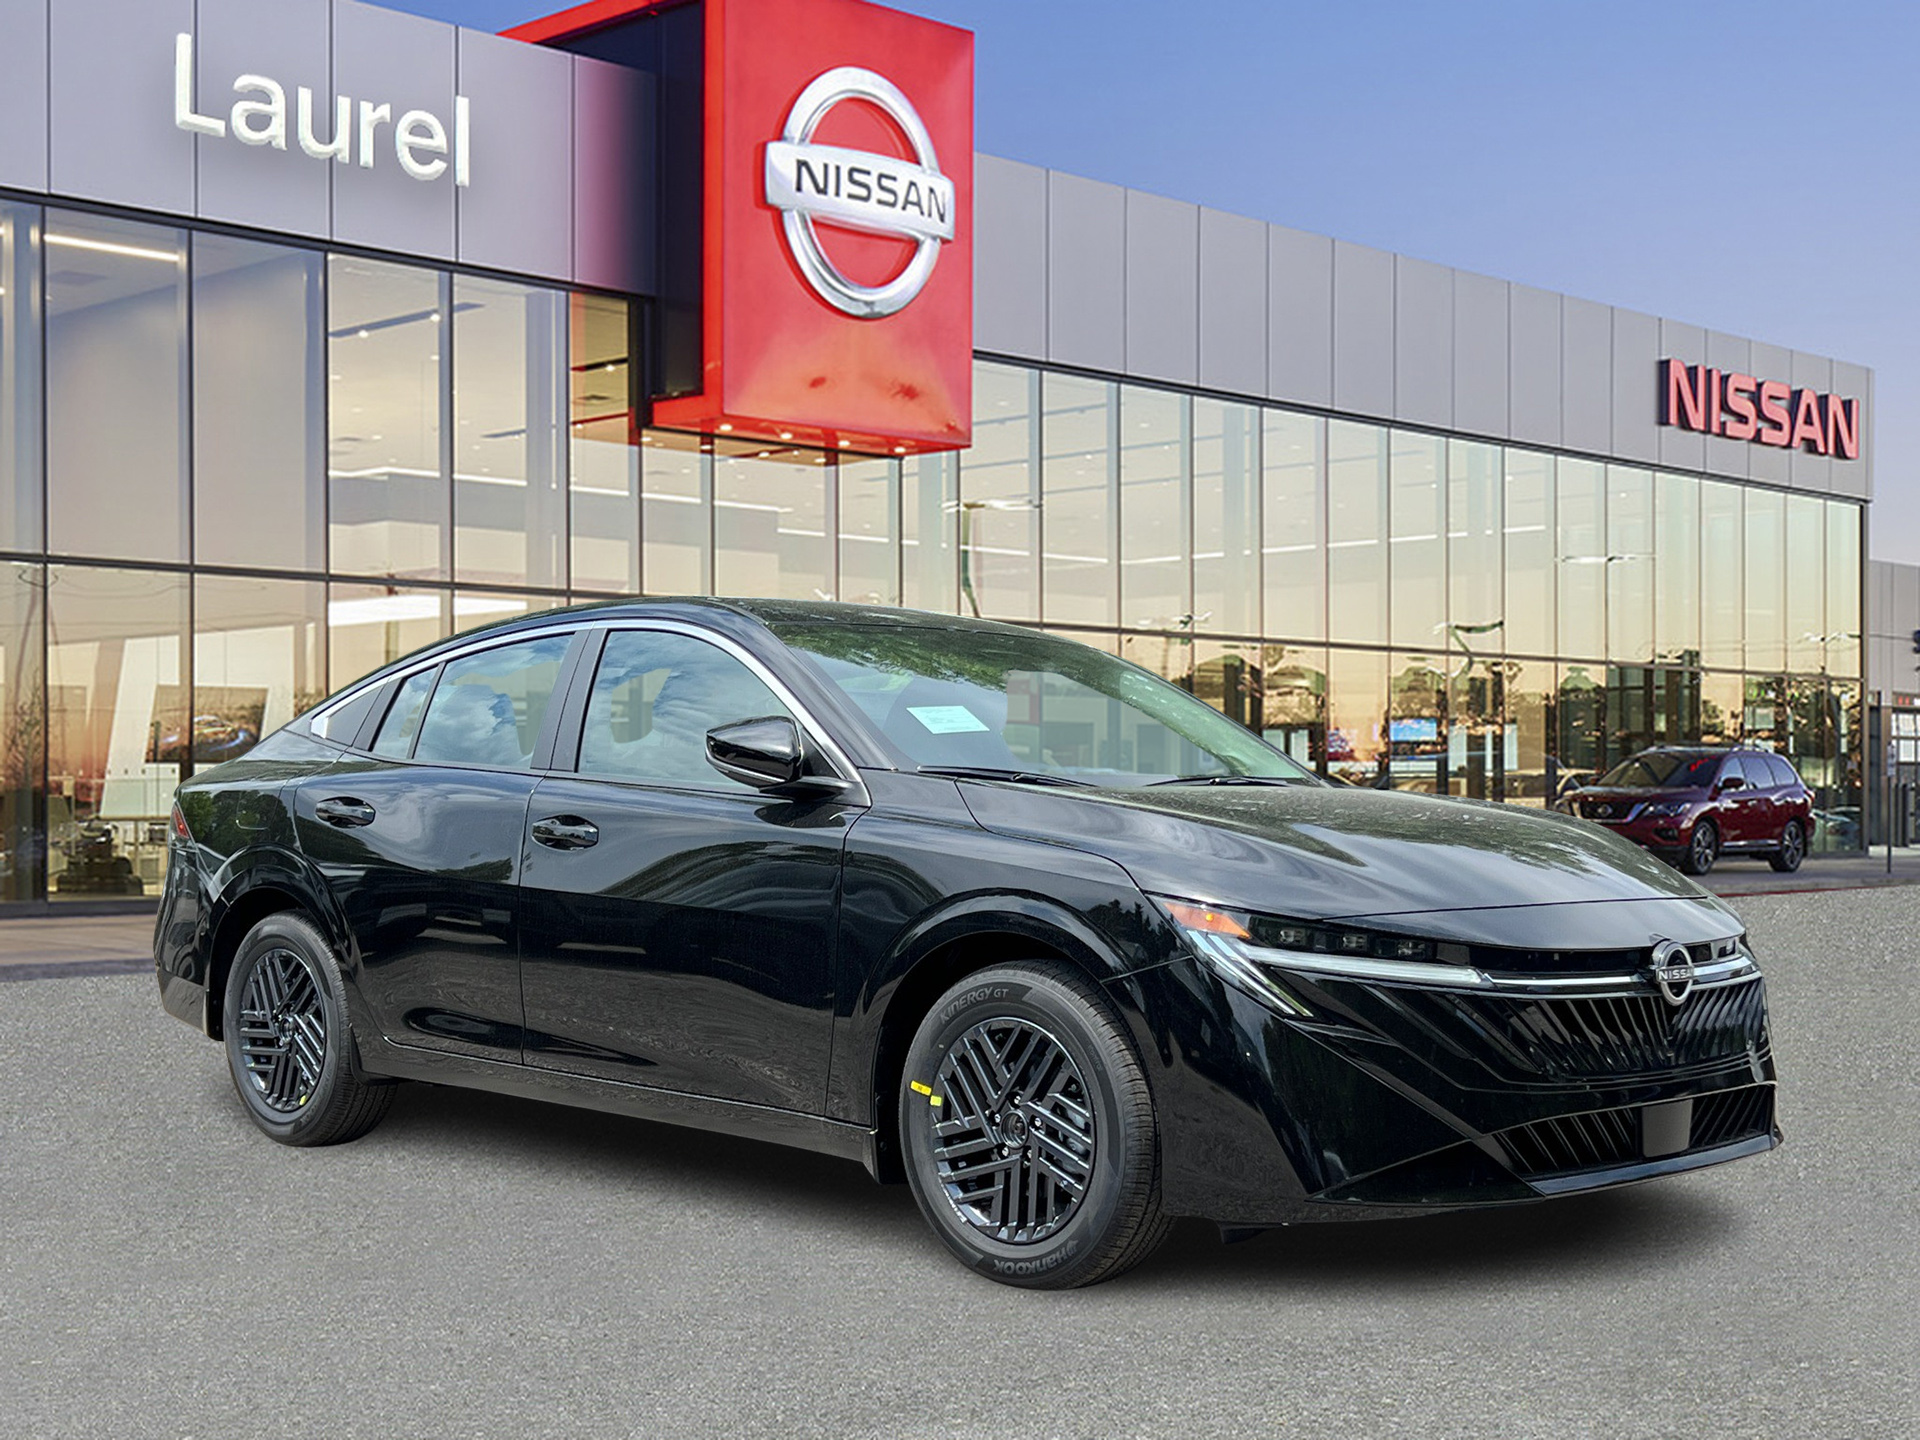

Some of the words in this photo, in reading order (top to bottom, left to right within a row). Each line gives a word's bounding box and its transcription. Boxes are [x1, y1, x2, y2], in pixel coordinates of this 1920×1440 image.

[175, 32, 470, 188] Laurel
[795, 158, 947, 224] NISSAN
[1657, 358, 1860, 460] NISSAN
[993, 988, 1009, 998] GT
[1658, 968, 1693, 980] NISSA
